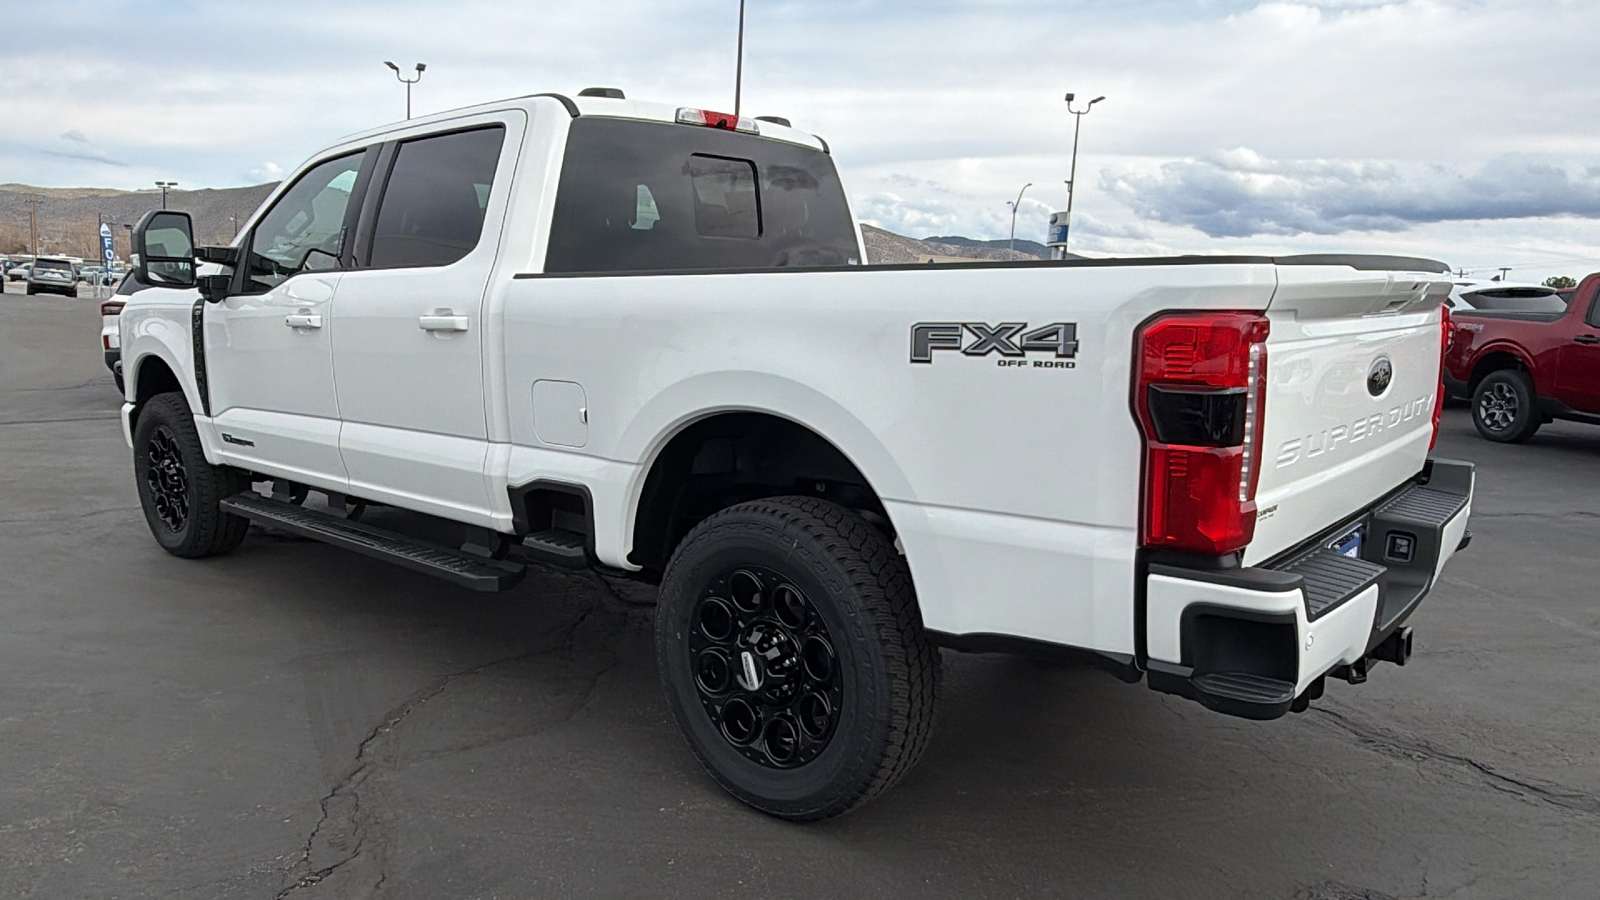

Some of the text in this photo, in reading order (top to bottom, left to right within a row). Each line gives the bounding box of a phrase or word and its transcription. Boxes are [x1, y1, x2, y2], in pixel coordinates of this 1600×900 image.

[909, 321, 1079, 364] FX4
[997, 359, 1076, 369] OFF ROAD
[1276, 393, 1434, 469] SUPER DUTY
